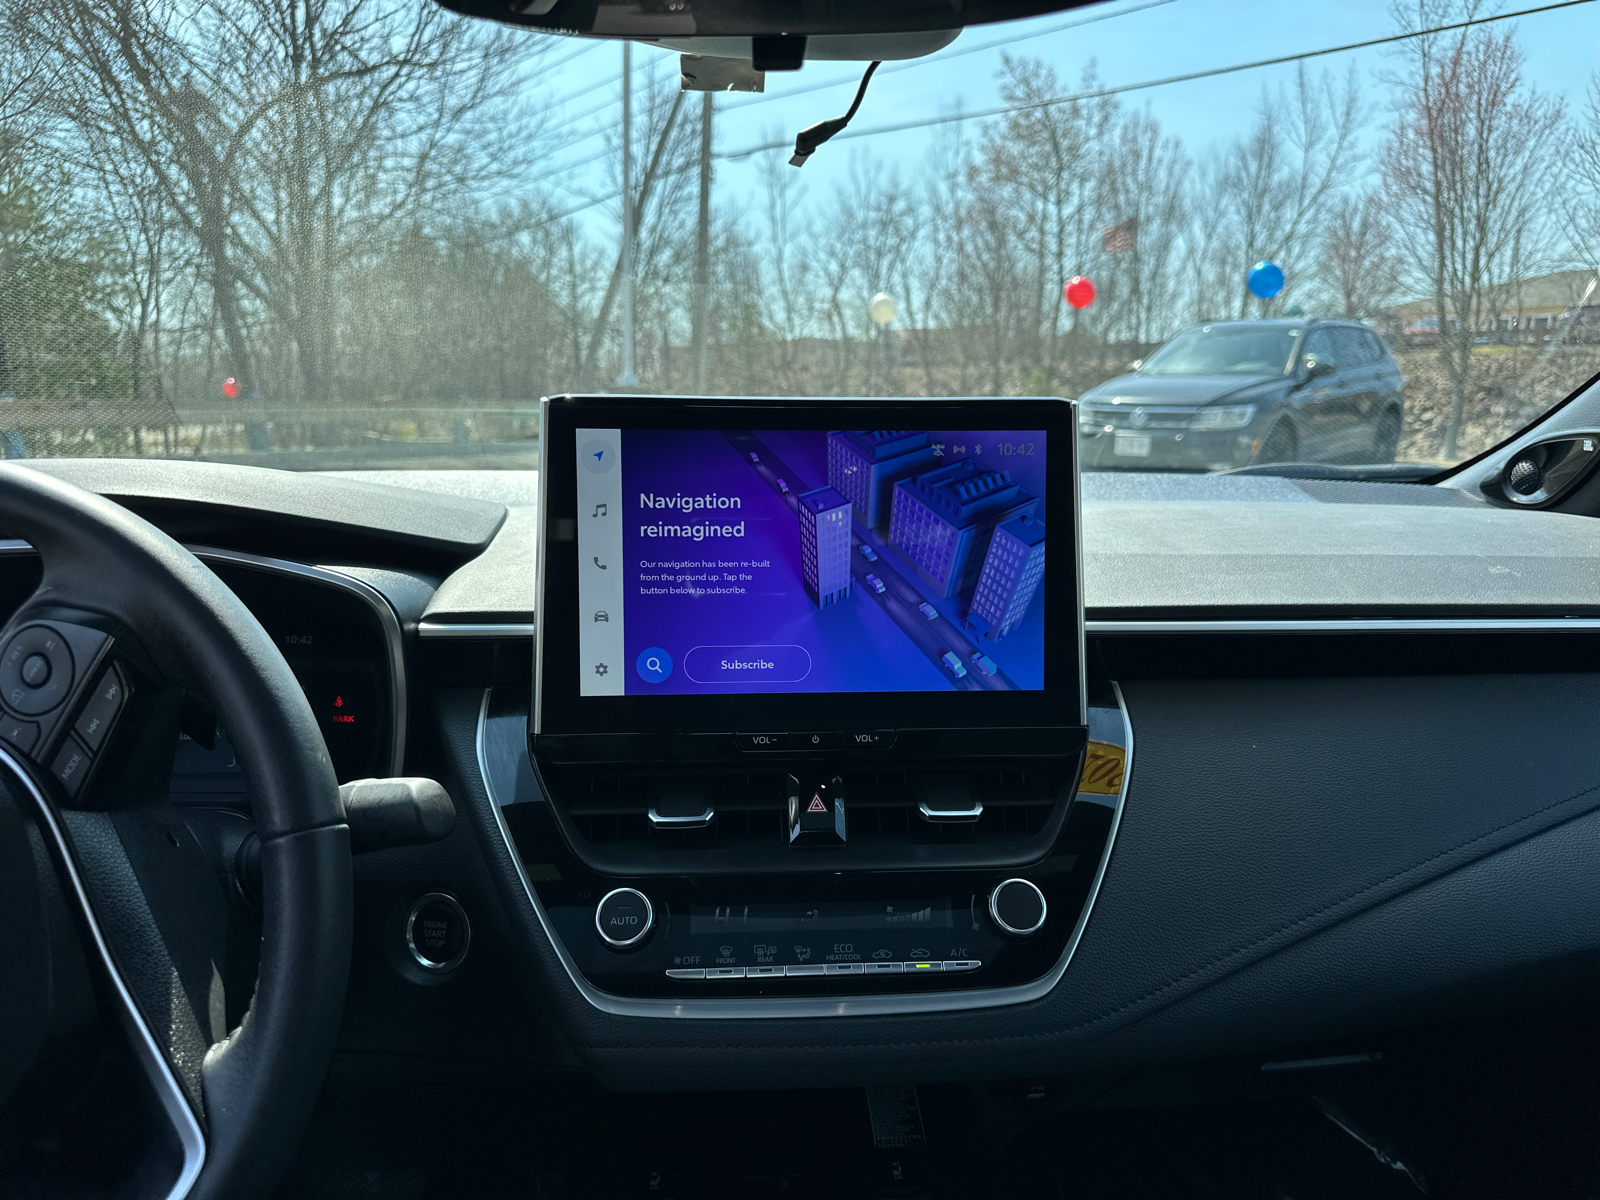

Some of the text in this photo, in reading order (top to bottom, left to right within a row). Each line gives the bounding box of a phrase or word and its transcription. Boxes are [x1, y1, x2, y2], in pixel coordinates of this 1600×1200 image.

[998, 443, 1034, 456] 10:42
[640, 492, 741, 513] Navigation
[640, 521, 745, 541] reimagined
[640, 560, 771, 569] Our navigation has been re-built
[640, 573, 753, 583] from the ground up. Tap the
[640, 587, 668, 595] button
[669, 587, 695, 595] below
[706, 586, 748, 594] subscribe.
[285, 635, 313, 644] 10:42
[721, 659, 774, 670] Subscribe
[61, 753, 83, 780] MODE
[423, 920, 448, 929] ENGINE
[610, 915, 638, 926] AUTO
[424, 929, 446, 938] START
[426, 939, 445, 947] STOP
[834, 943, 853, 953] ECO
[950, 948, 968, 957] A/C
[682, 956, 701, 965] OFF
[826, 953, 862, 961] HEAT/COOL
